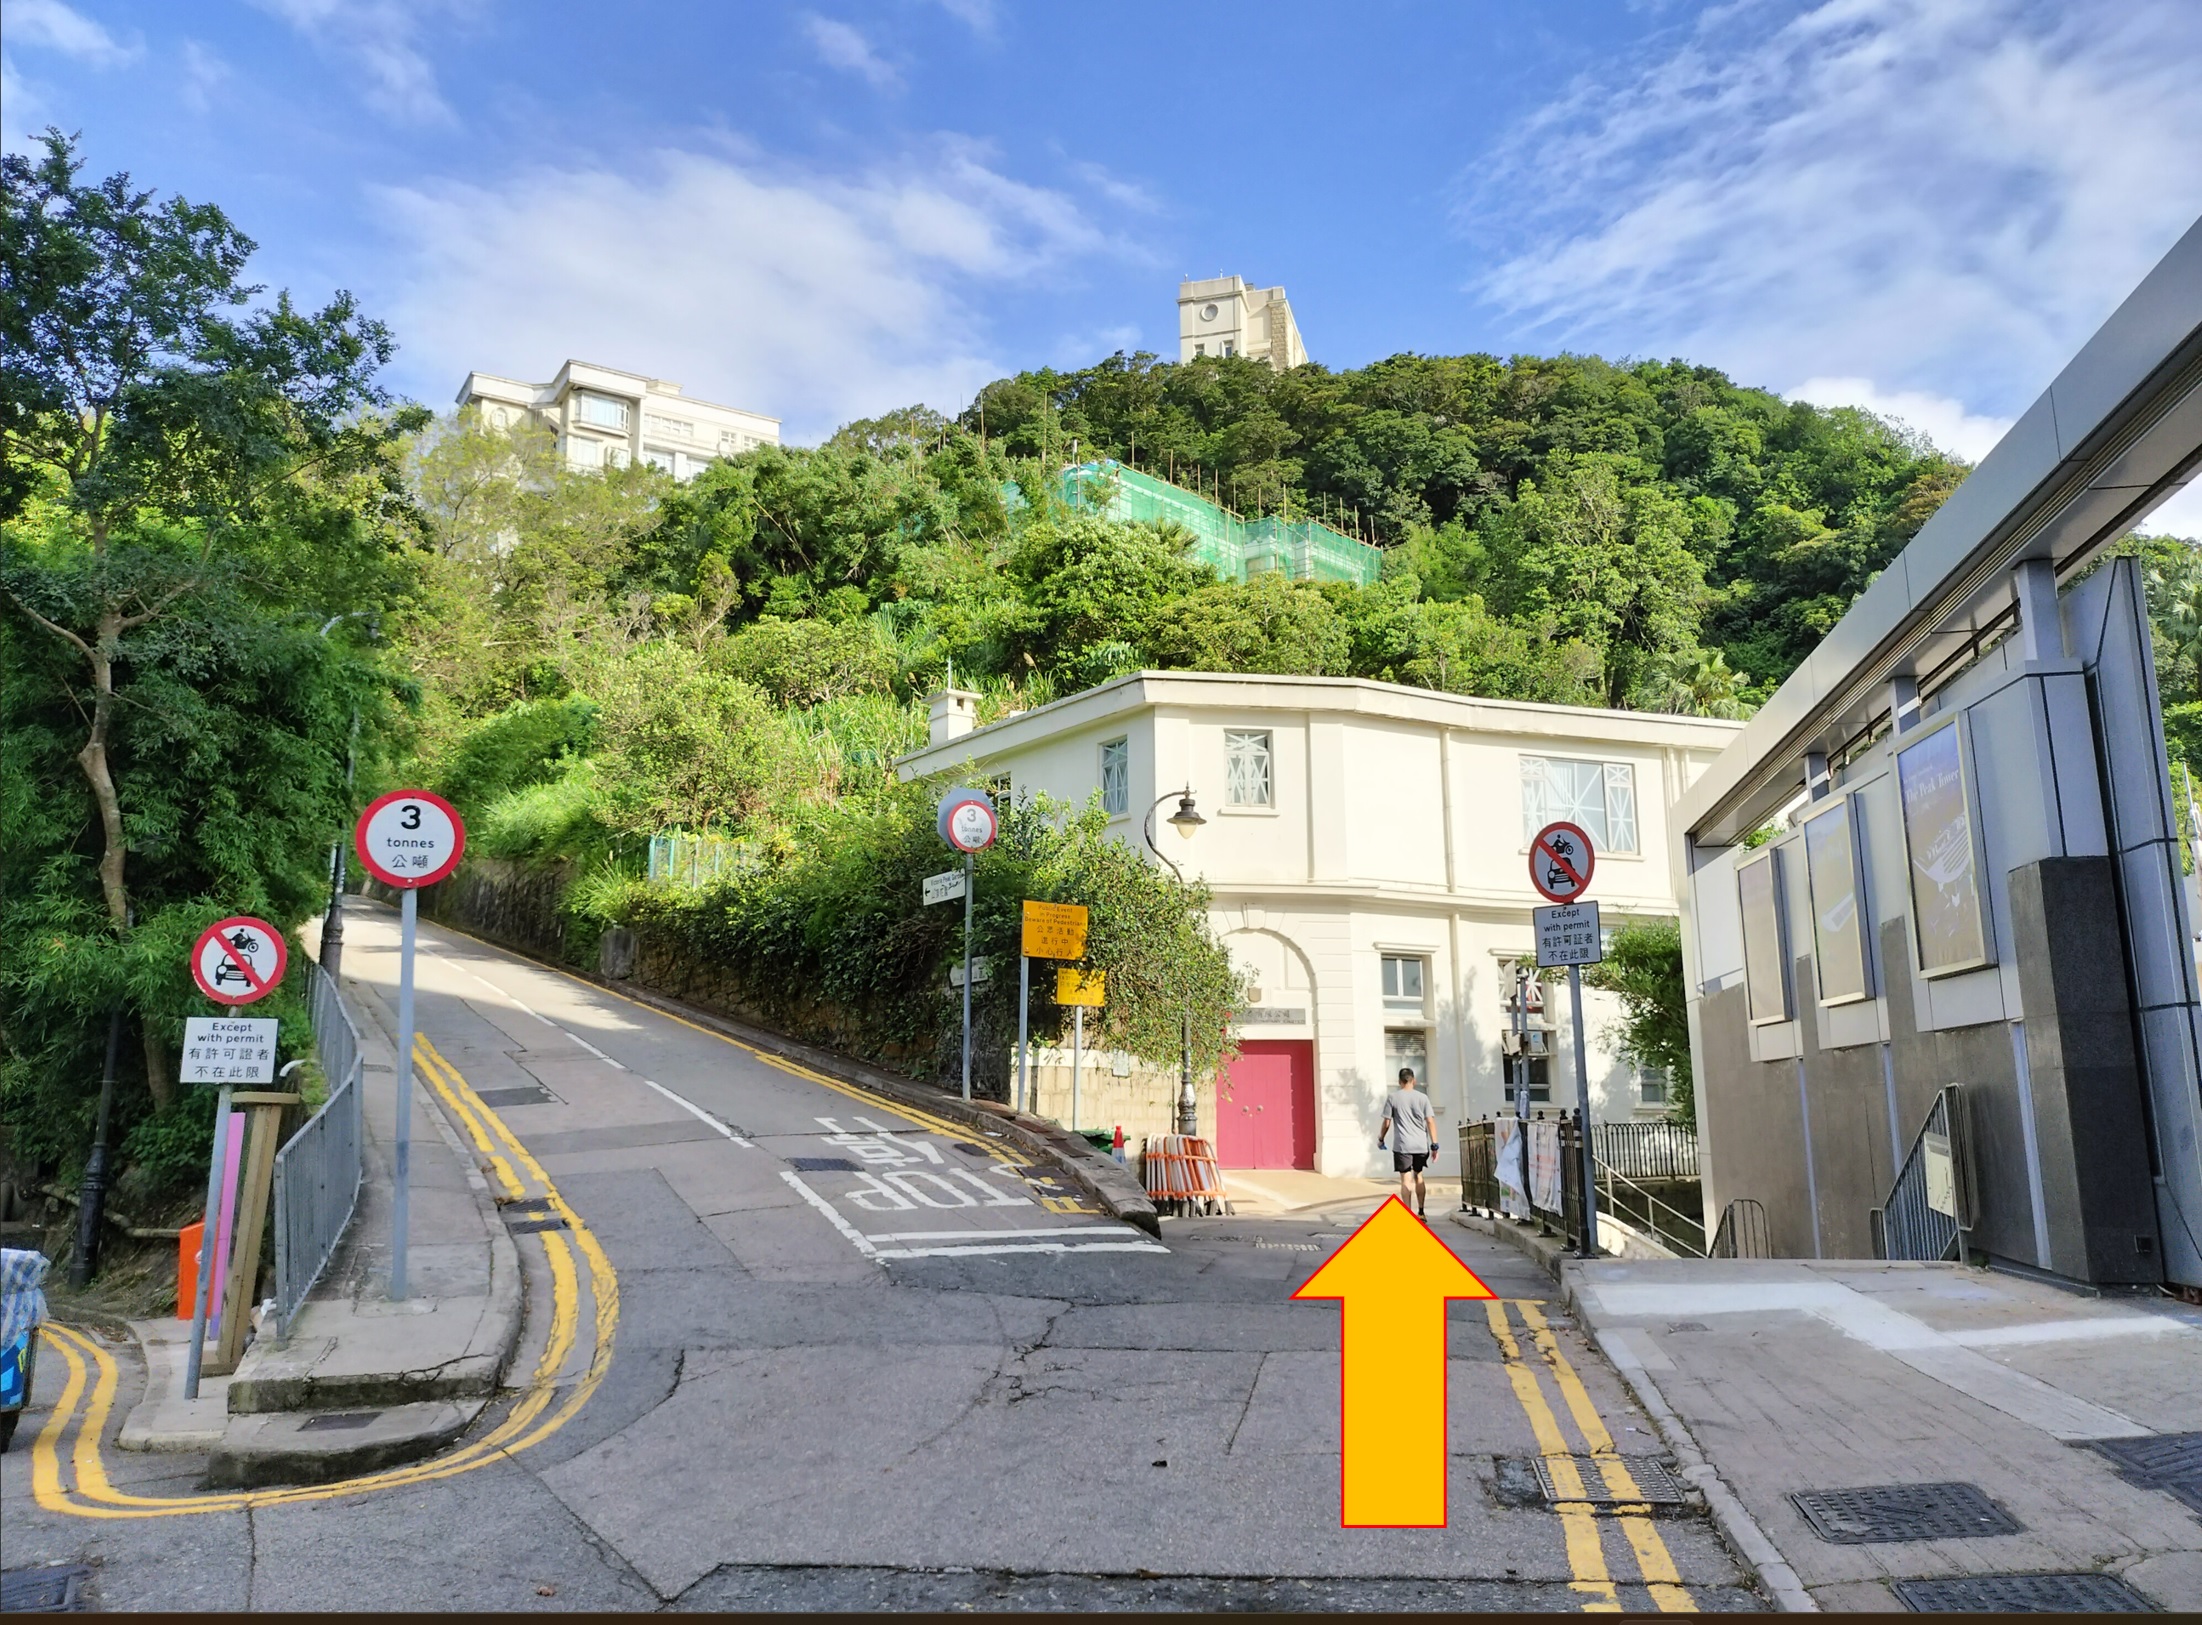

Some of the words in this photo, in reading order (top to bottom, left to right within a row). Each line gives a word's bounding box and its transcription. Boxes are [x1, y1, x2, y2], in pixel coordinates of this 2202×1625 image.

[401, 805, 421, 830] 3
[967, 808, 977, 822] 3
[961, 825, 983, 833] tonnes
[386, 837, 435, 848] tonnes
[392, 854, 429, 868] 公噸
[1551, 908, 1580, 919] Except
[1543, 923, 1561, 932] with
[1563, 920, 1590, 932] permit
[1542, 933, 1594, 949] 有許可証者
[1036, 946, 1074, 957] 小心行人
[1548, 947, 1590, 961] 不在此限
[212, 1022, 252, 1032] Except
[197, 1033, 222, 1042] with
[226, 1034, 264, 1044] permit
[188, 1047, 270, 1060] 有許可證者
[194, 1065, 260, 1079] 不在此限
[813, 1116, 945, 1168] 停
[845, 1163, 1084, 1211] STOP
